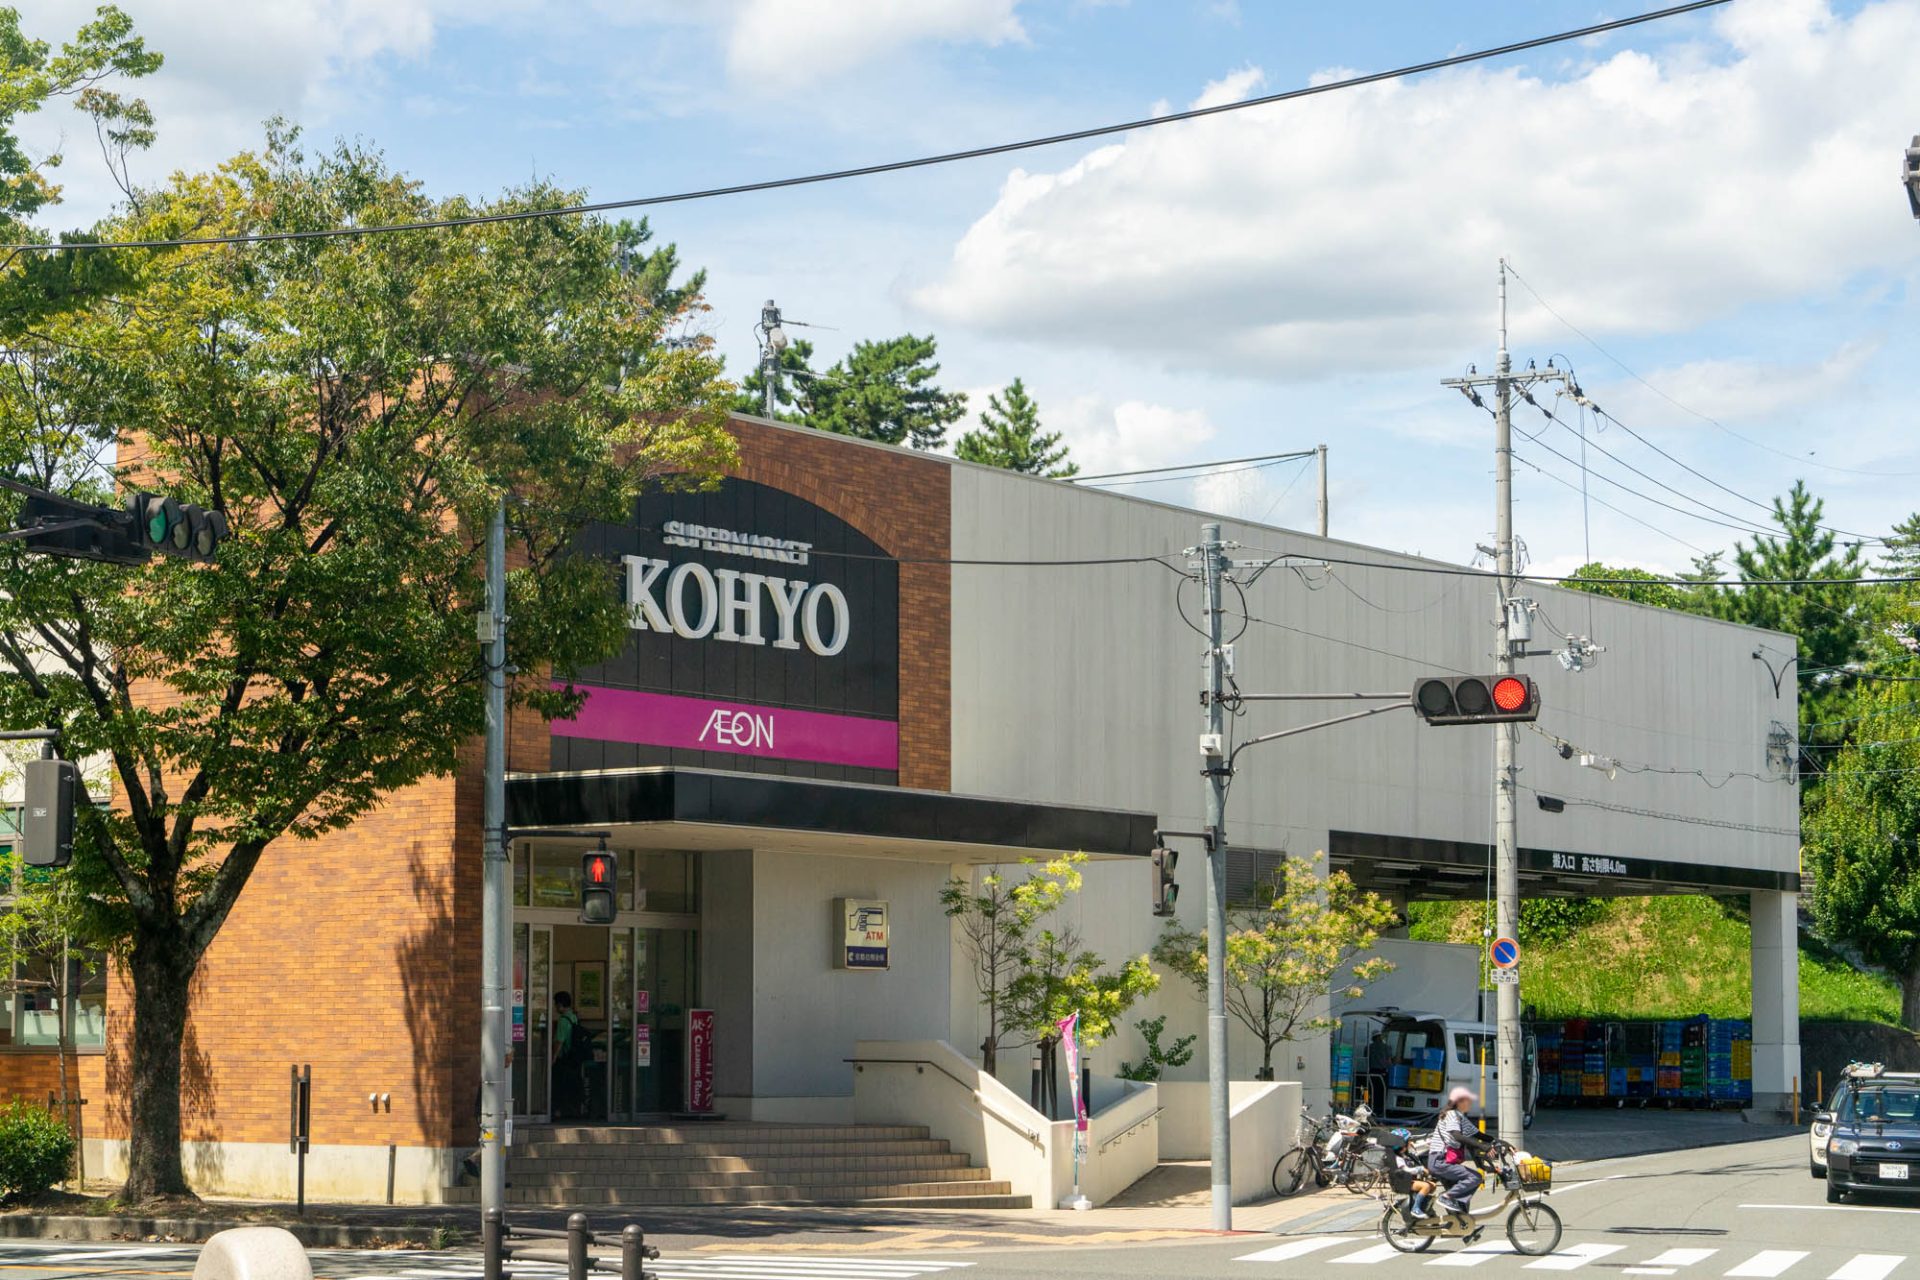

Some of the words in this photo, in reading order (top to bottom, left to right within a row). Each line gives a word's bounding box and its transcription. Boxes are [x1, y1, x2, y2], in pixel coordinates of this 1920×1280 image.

[663, 520, 813, 566] SUPERMARKET
[621, 554, 850, 656] KOHYO
[865, 931, 884, 941] ATM
